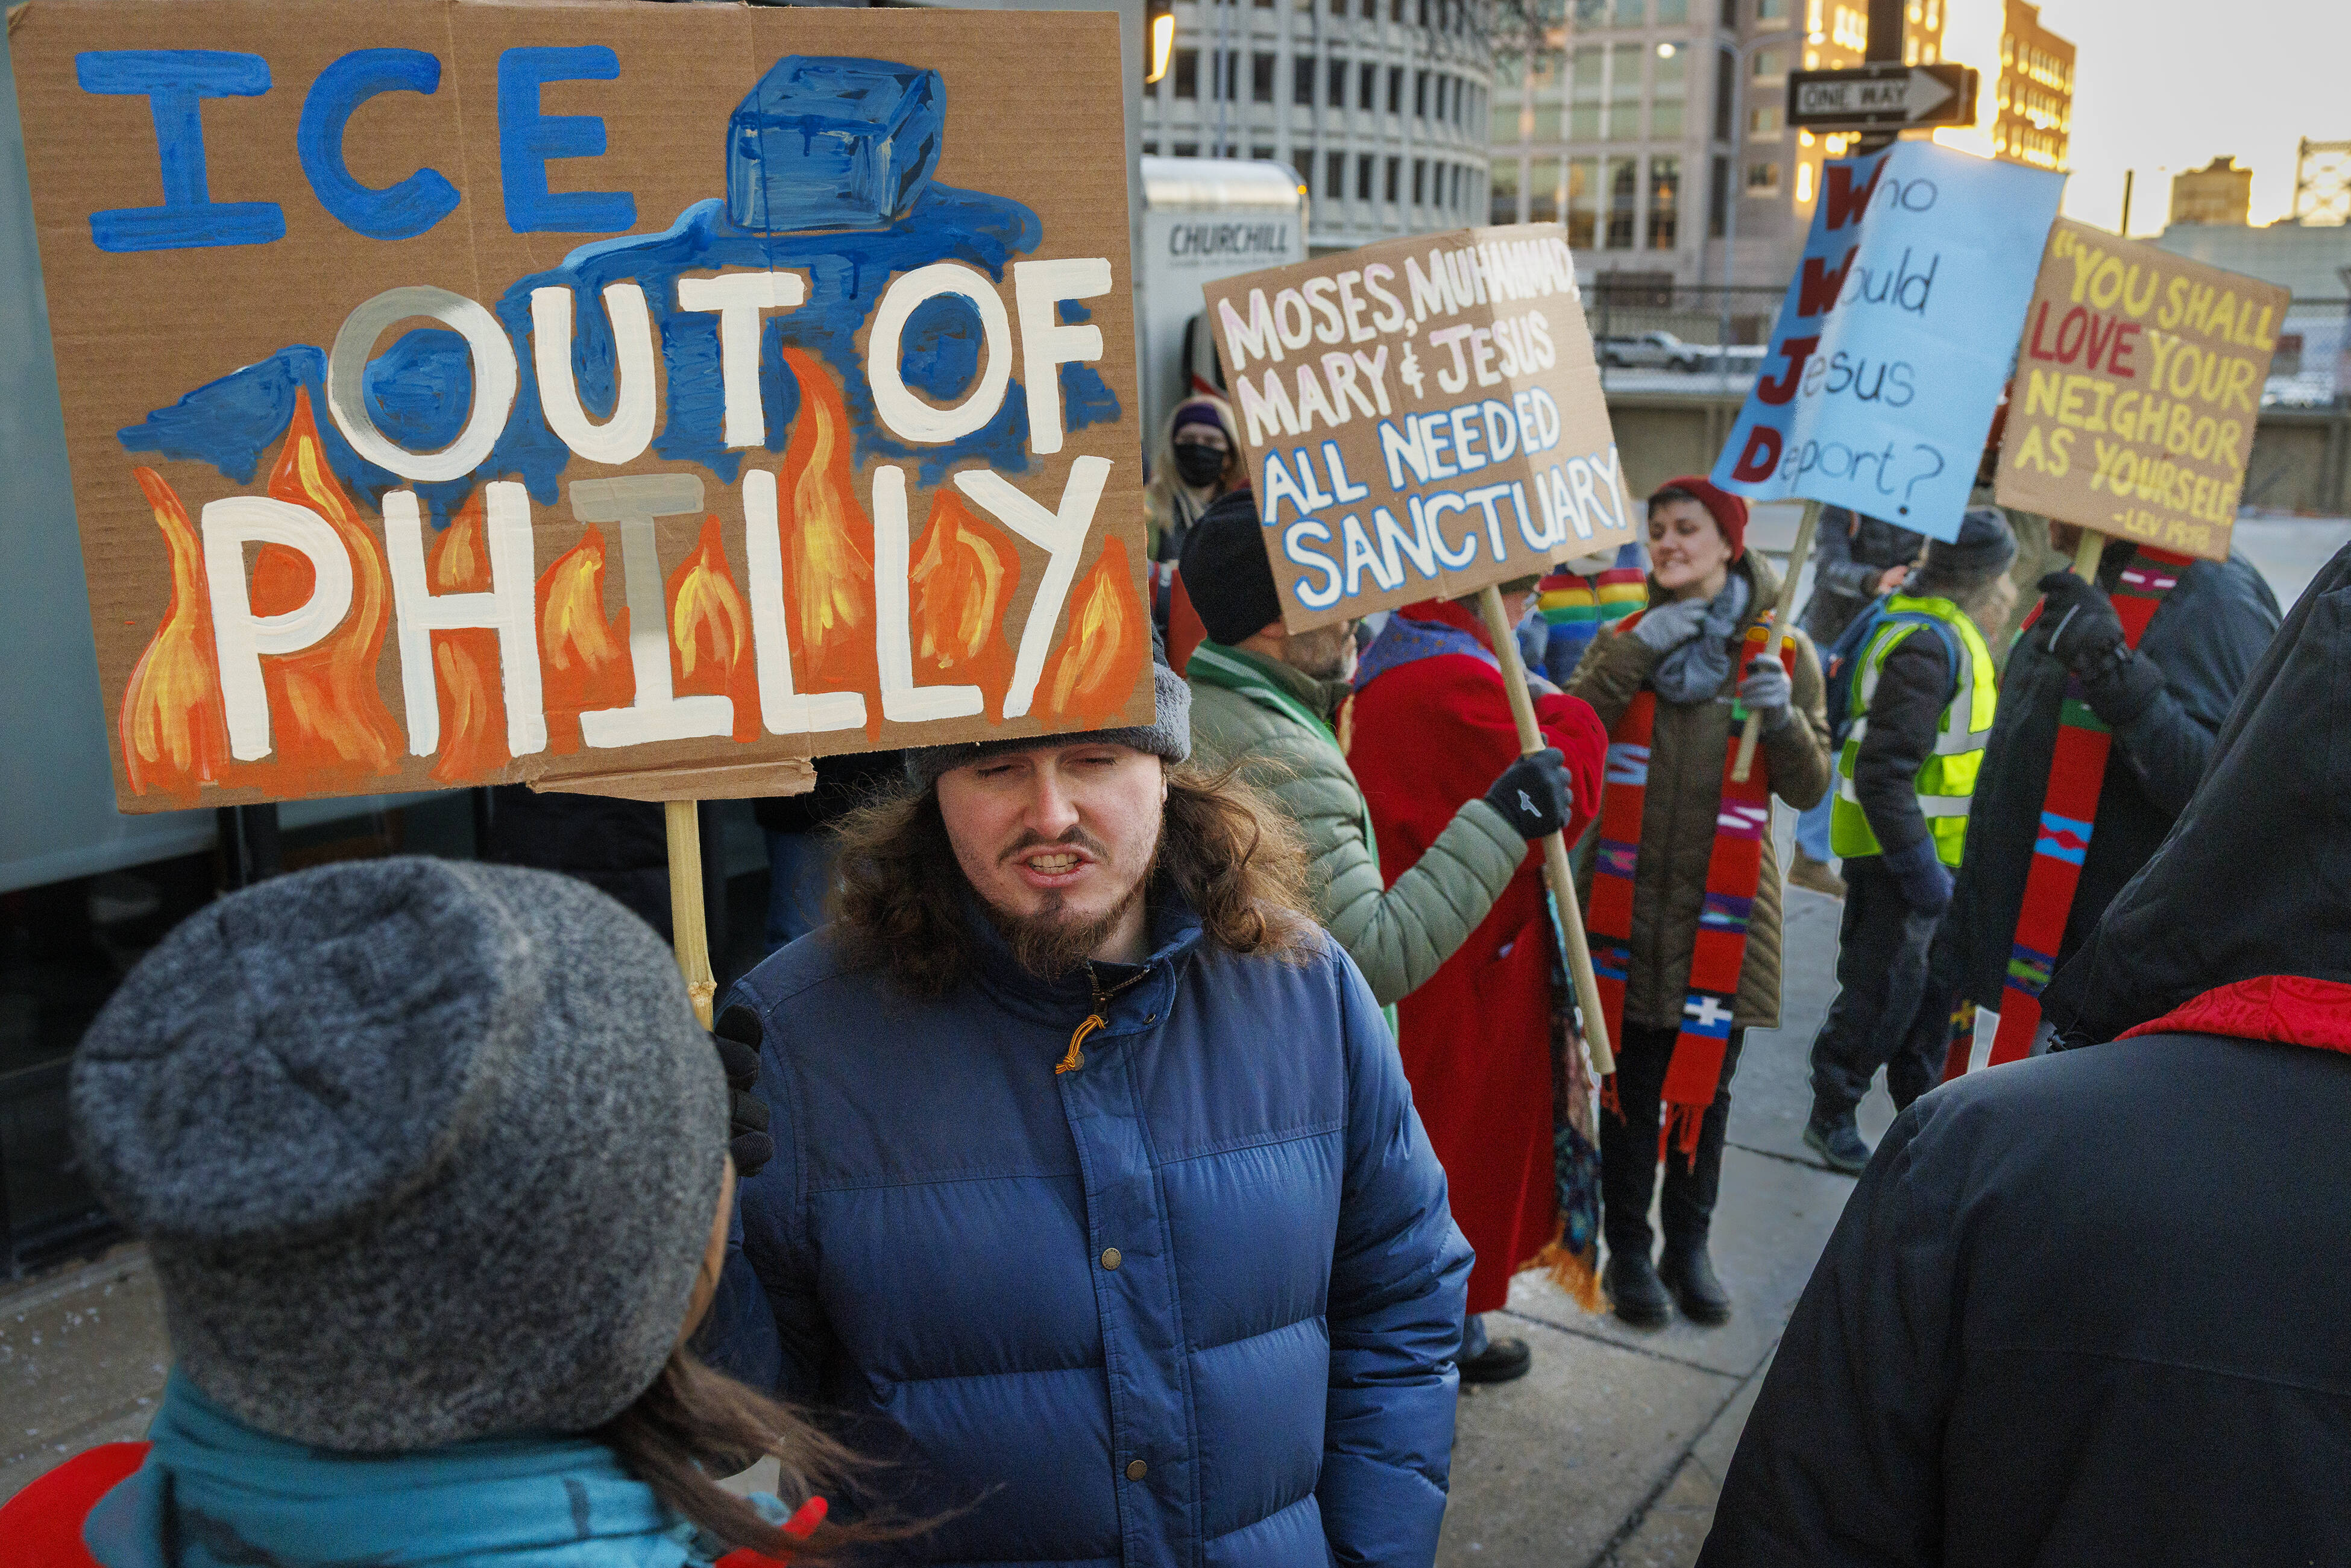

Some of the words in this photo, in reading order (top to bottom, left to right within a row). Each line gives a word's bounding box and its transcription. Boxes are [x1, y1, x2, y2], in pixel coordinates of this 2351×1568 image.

[1804, 83, 1846, 112] ONE
[1860, 81, 1908, 107] WAY
[75, 45, 637, 253] ICE
[1168, 222, 1288, 256] CHURCHILL
[1797, 244, 1940, 318] Would
[1218, 263, 1417, 370] MOSES,
[2029, 301, 2141, 378] LOVE
[2148, 329, 2257, 413] YOUR
[2157, 276, 2276, 351] SHALL
[328, 272, 808, 482] OUT
[868, 257, 1112, 454] OF
[1236, 345, 1391, 447] MARY
[1400, 341, 1424, 399] &
[1429, 310, 1556, 394] JESUS
[1757, 335, 1915, 408] Jesus
[2024, 369, 2242, 468] NEIGHBOR
[1263, 440, 1368, 525] ALL
[1378, 387, 1561, 491] NEEDED
[1731, 424, 1945, 515] Deport?
[2014, 425, 2076, 478] AS
[1283, 442, 1628, 611] SANCTUARY
[200, 456, 1117, 761] PHILLY
